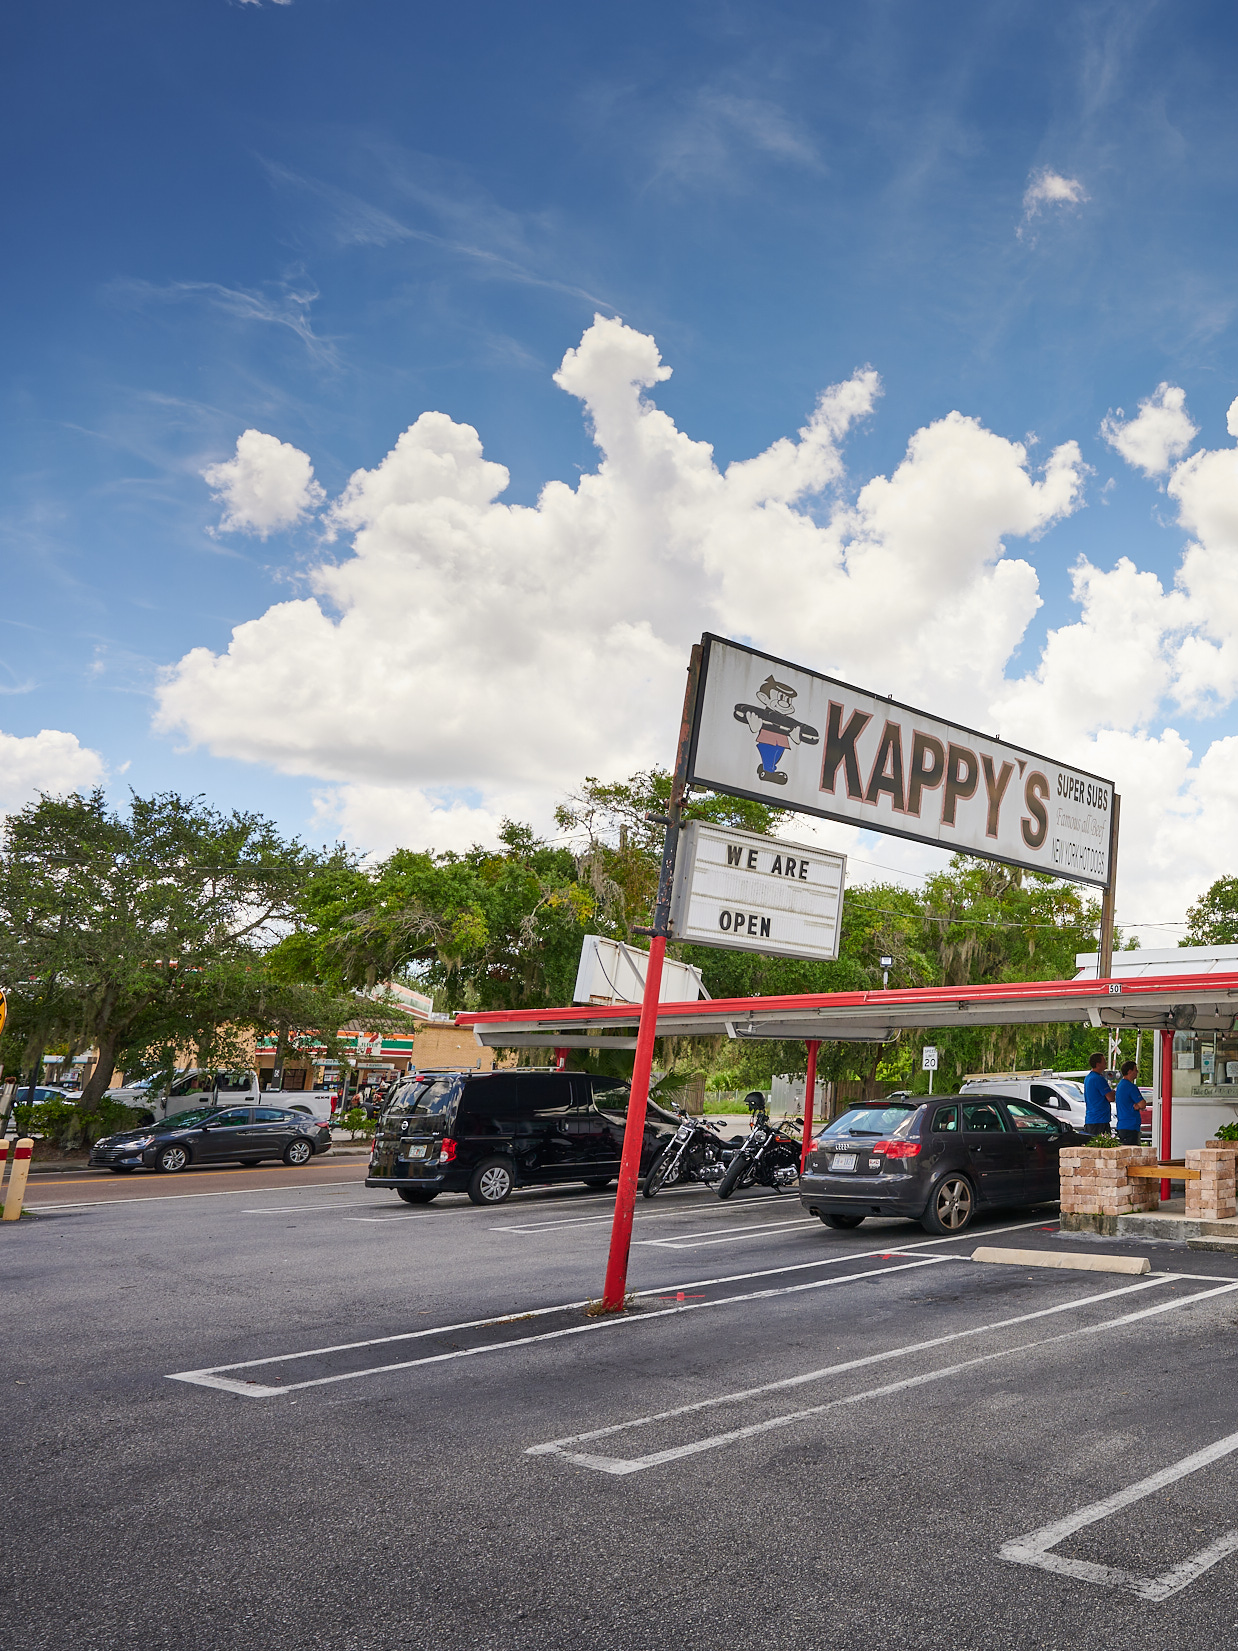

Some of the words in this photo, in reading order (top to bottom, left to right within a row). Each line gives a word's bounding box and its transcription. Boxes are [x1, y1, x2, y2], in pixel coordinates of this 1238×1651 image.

[819, 700, 1050, 850] KAPPY'S
[1057, 773, 1085, 804] SUPER
[1086, 784, 1108, 811] SUBS
[1056, 808, 1081, 832] Famous
[1090, 818, 1107, 844] Beef
[727, 845, 758, 870] WE
[771, 854, 810, 880] ARE
[1051, 837, 1065, 864] NEW
[1064, 842, 1080, 869] YORK
[1079, 847, 1091, 871] HOT
[1090, 850, 1105, 875] DOGS
[719, 910, 771, 938] OPEN
[1109, 984, 1122, 993] 501
[924, 1058, 936, 1067] 20
